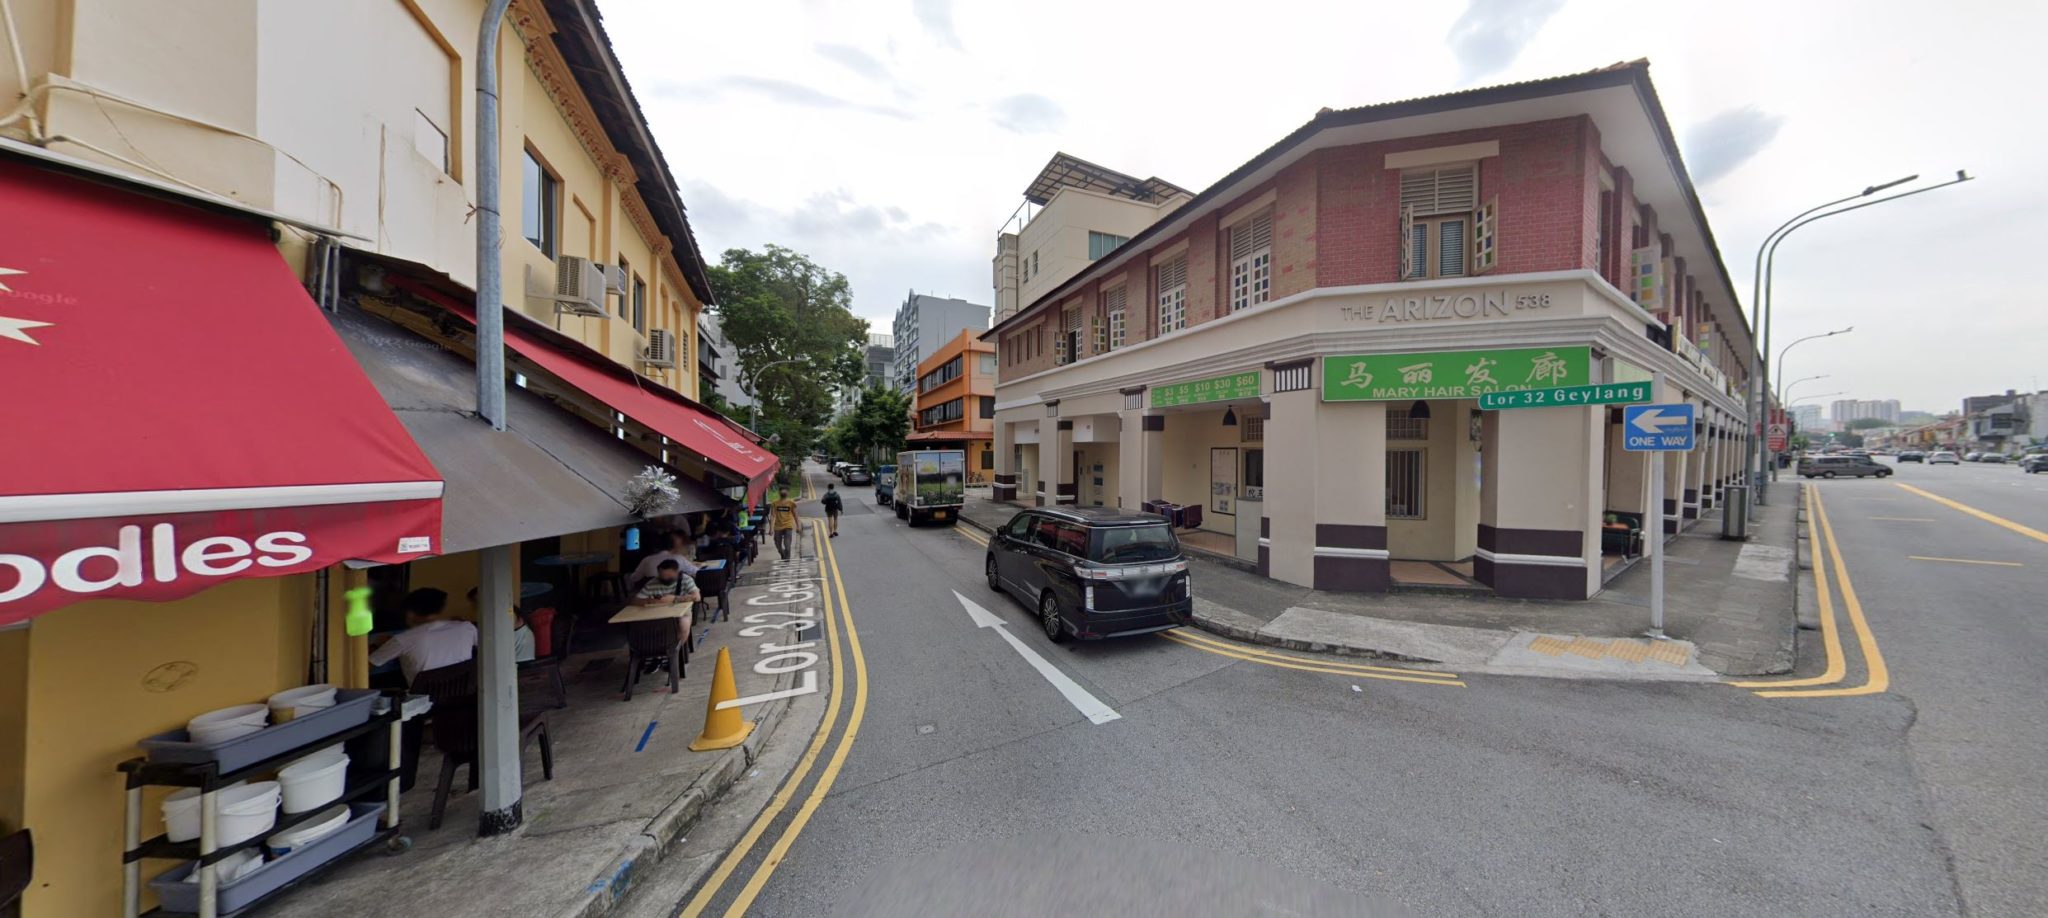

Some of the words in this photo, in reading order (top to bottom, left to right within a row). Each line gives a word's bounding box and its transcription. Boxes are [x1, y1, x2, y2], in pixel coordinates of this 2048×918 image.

[1341, 306, 1374, 321] THE
[1378, 290, 1510, 323] ARIZON
[1515, 294, 1551, 310] 538
[1340, 351, 1568, 389] 马丽发廊
[1195, 382, 1210, 392] $10
[1214, 379, 1231, 390] $30
[1236, 375, 1255, 387] $60
[1372, 386, 1420, 398] MARY
[1423, 386, 1466, 398] HAIR
[1487, 394, 1516, 406] Lor
[1524, 391, 1546, 404] 32
[1553, 386, 1644, 403] Geylang
[1629, 436, 1656, 447] ONE
[1660, 436, 1688, 447] WAY
